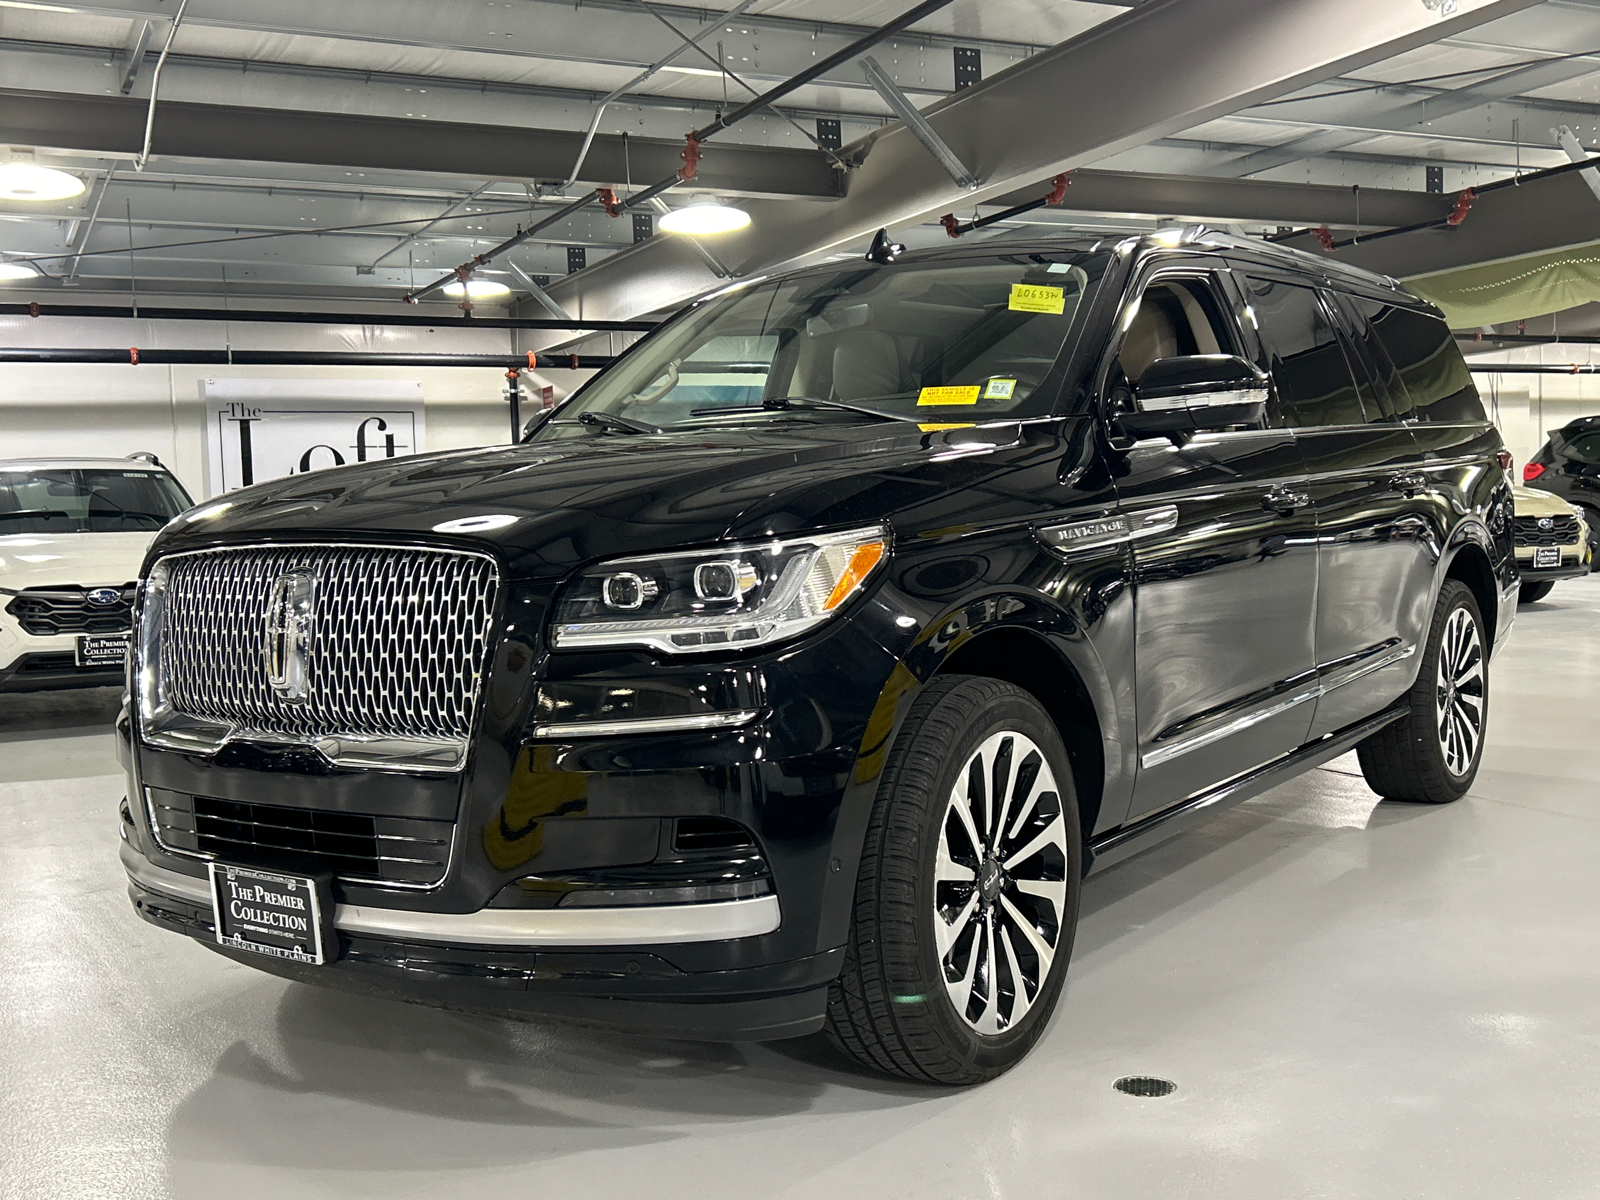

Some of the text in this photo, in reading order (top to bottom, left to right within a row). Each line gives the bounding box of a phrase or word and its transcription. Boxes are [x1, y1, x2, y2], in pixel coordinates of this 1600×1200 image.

[226, 402, 262, 417] The
[84, 647, 126, 655] COLLECTIO
[227, 881, 306, 911] THE PREMIER
[230, 900, 307, 932] COLLECTION
[258, 946, 282, 956] WHITE
[284, 951, 313, 962] PLAINS
